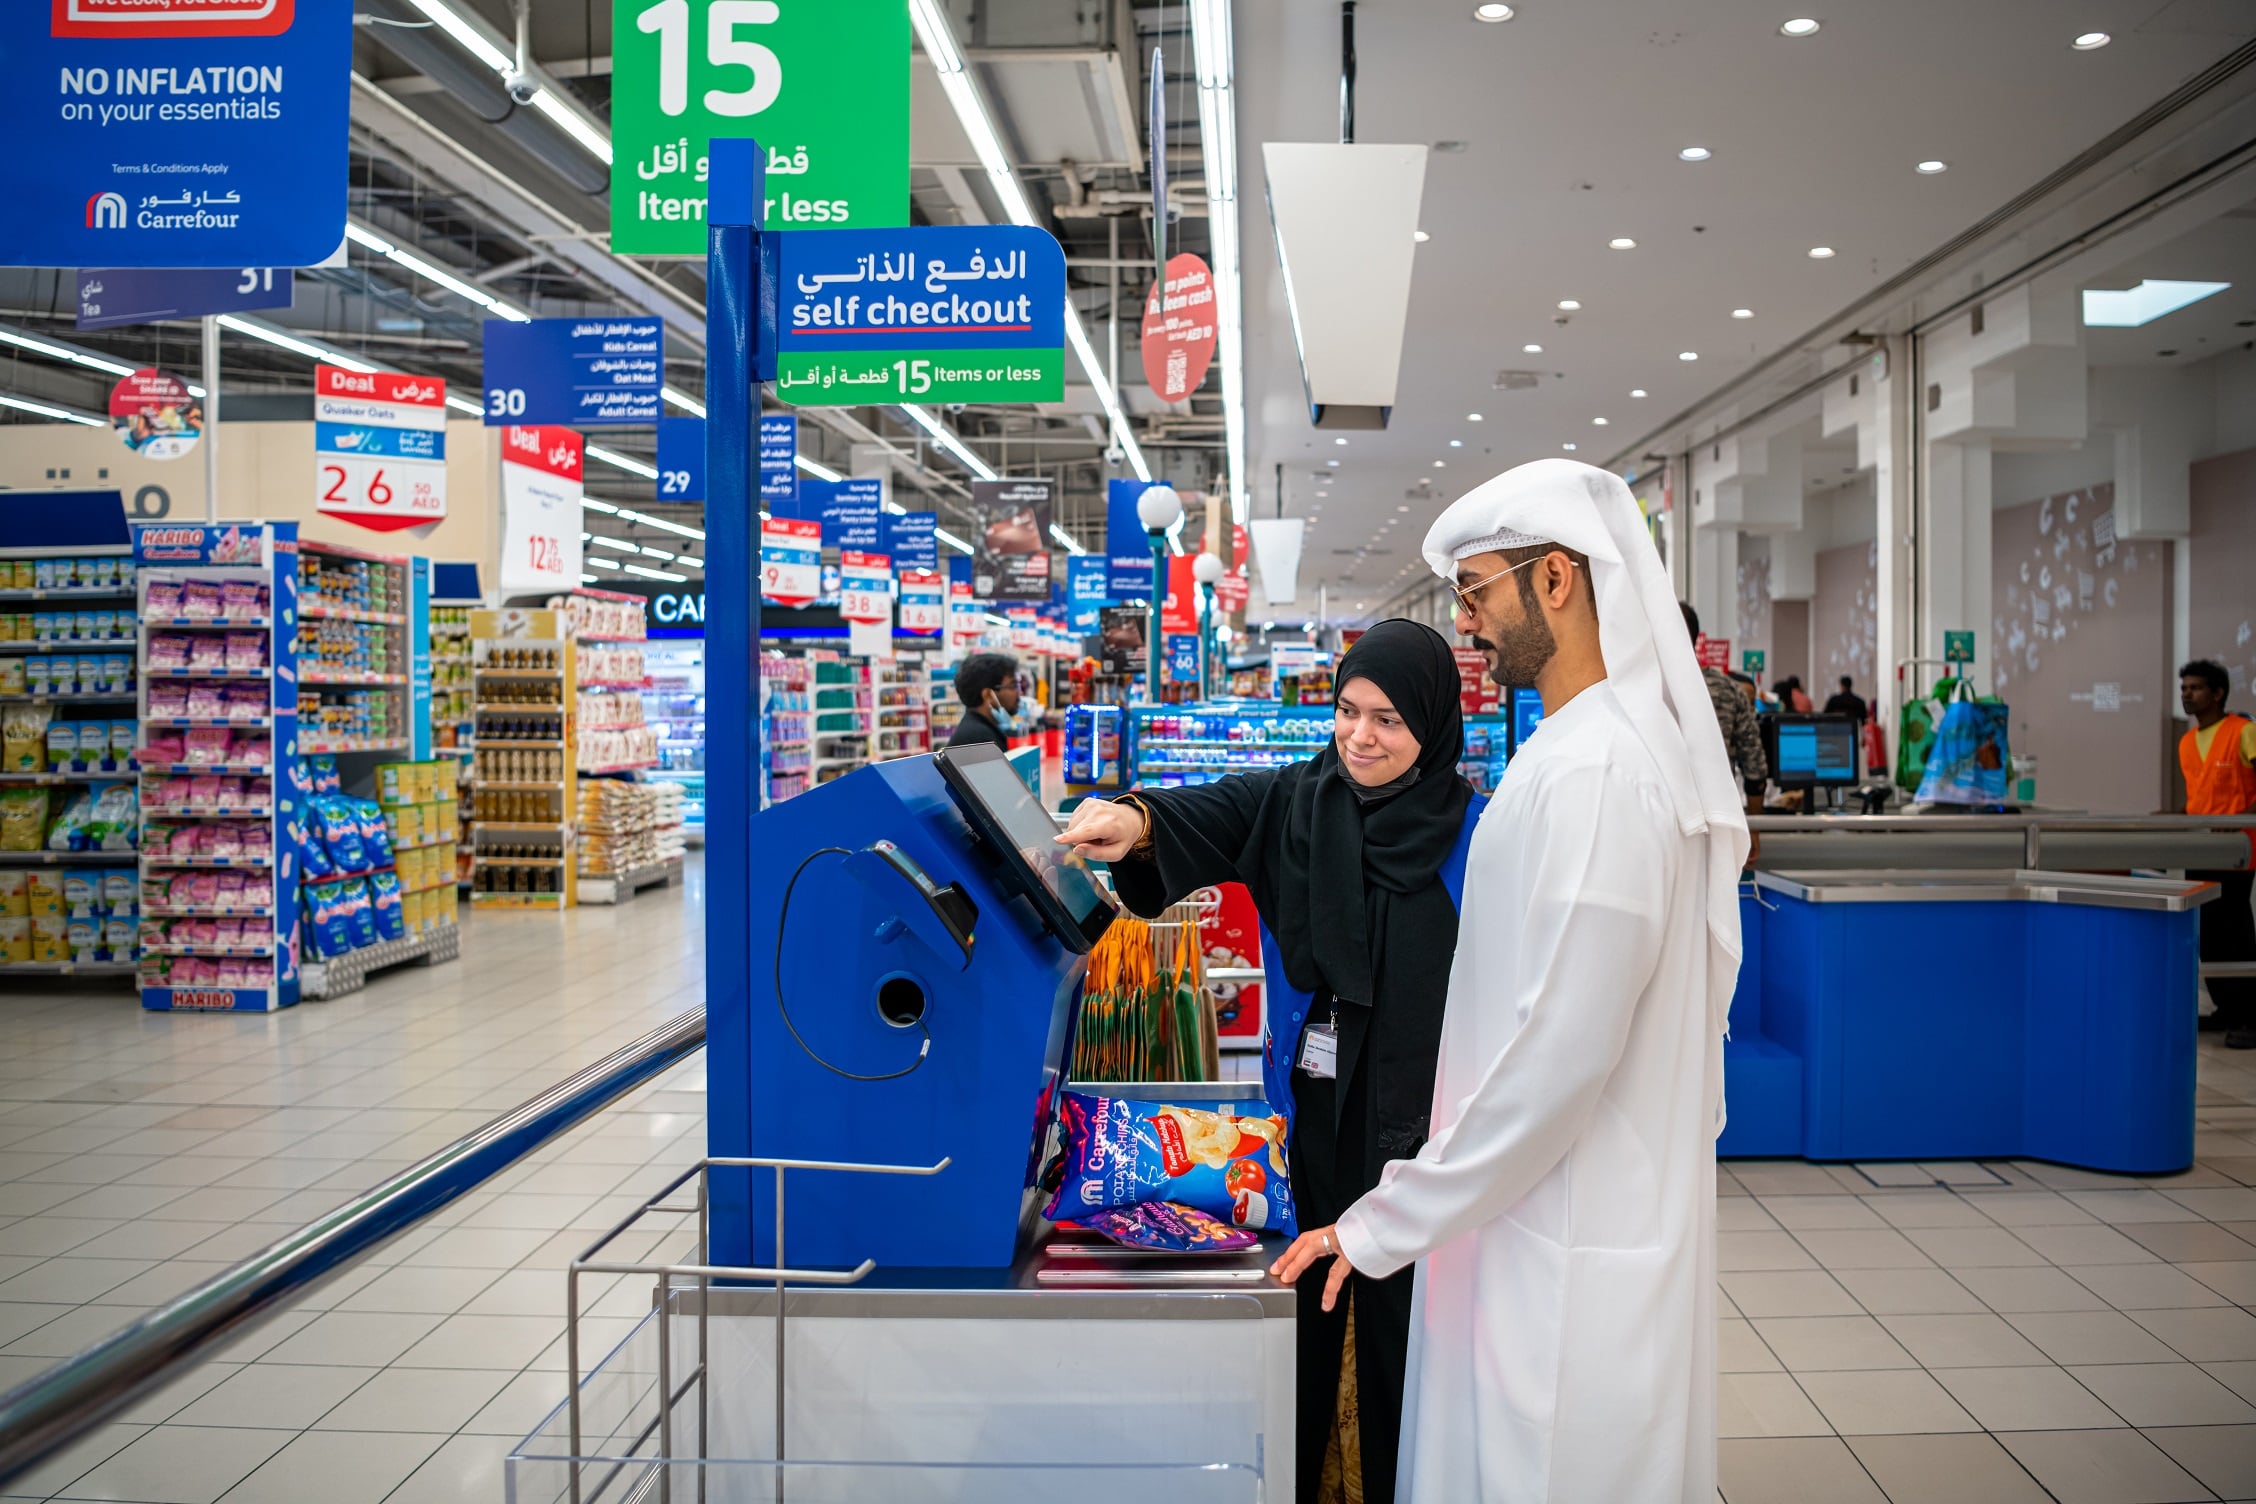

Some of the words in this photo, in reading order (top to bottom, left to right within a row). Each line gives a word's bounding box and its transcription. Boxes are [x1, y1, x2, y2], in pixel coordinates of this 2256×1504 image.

[637, 0, 782, 117] 15
[60, 67, 109, 95] NO
[116, 66, 283, 95] INFLATION
[61, 103, 93, 120] on
[99, 102, 154, 126] your
[159, 97, 280, 120] essentials
[112, 163, 141, 174] Terms
[142, 163, 149, 173] &
[151, 163, 200, 174] Conditions
[201, 163, 229, 175] Apply
[637, 137, 688, 180] أقل
[766, 145, 809, 174] قط
[139, 188, 241, 208] كارفور
[638, 190, 709, 221] Item
[764, 198, 776, 221] r
[782, 192, 849, 222] less
[137, 210, 240, 229] Carrefour
[797, 252, 915, 300] الذاتي
[925, 248, 1026, 293] الدفع
[82, 302, 101, 317] Tea
[793, 296, 861, 327] self
[867, 293, 1032, 325] checkout
[604, 342, 626, 351] Kids
[627, 341, 657, 351] Cereal
[330, 371, 376, 393] Deal
[633, 373, 656, 383] Meal
[780, 366, 820, 389] أقل
[823, 365, 837, 389] أو
[839, 367, 889, 384] قطعة
[893, 359, 931, 394] 15
[934, 366, 982, 382] Items
[986, 369, 1004, 382] or
[1007, 366, 1042, 382] less
[392, 381, 437, 402] عرض
[488, 388, 527, 416] 30
[322, 403, 365, 417] Quaker
[367, 406, 396, 419] Oats
[599, 406, 625, 416] Adult
[627, 406, 657, 415] Cereal
[509, 424, 542, 455] Deal
[662, 470, 692, 494] 29
[411, 496, 441, 510] AED
[142, 529, 204, 547] HARIBO
[529, 534, 547, 571] 12
[767, 567, 779, 587] 9
[172, 990, 236, 1009] HARIBO
[1088, 1097, 1110, 1171] Carrefour
[1158, 1117, 1171, 1143] Ketchup
[1165, 1145, 1179, 1171] Tomato
[1113, 1150, 1128, 1206] POTA
